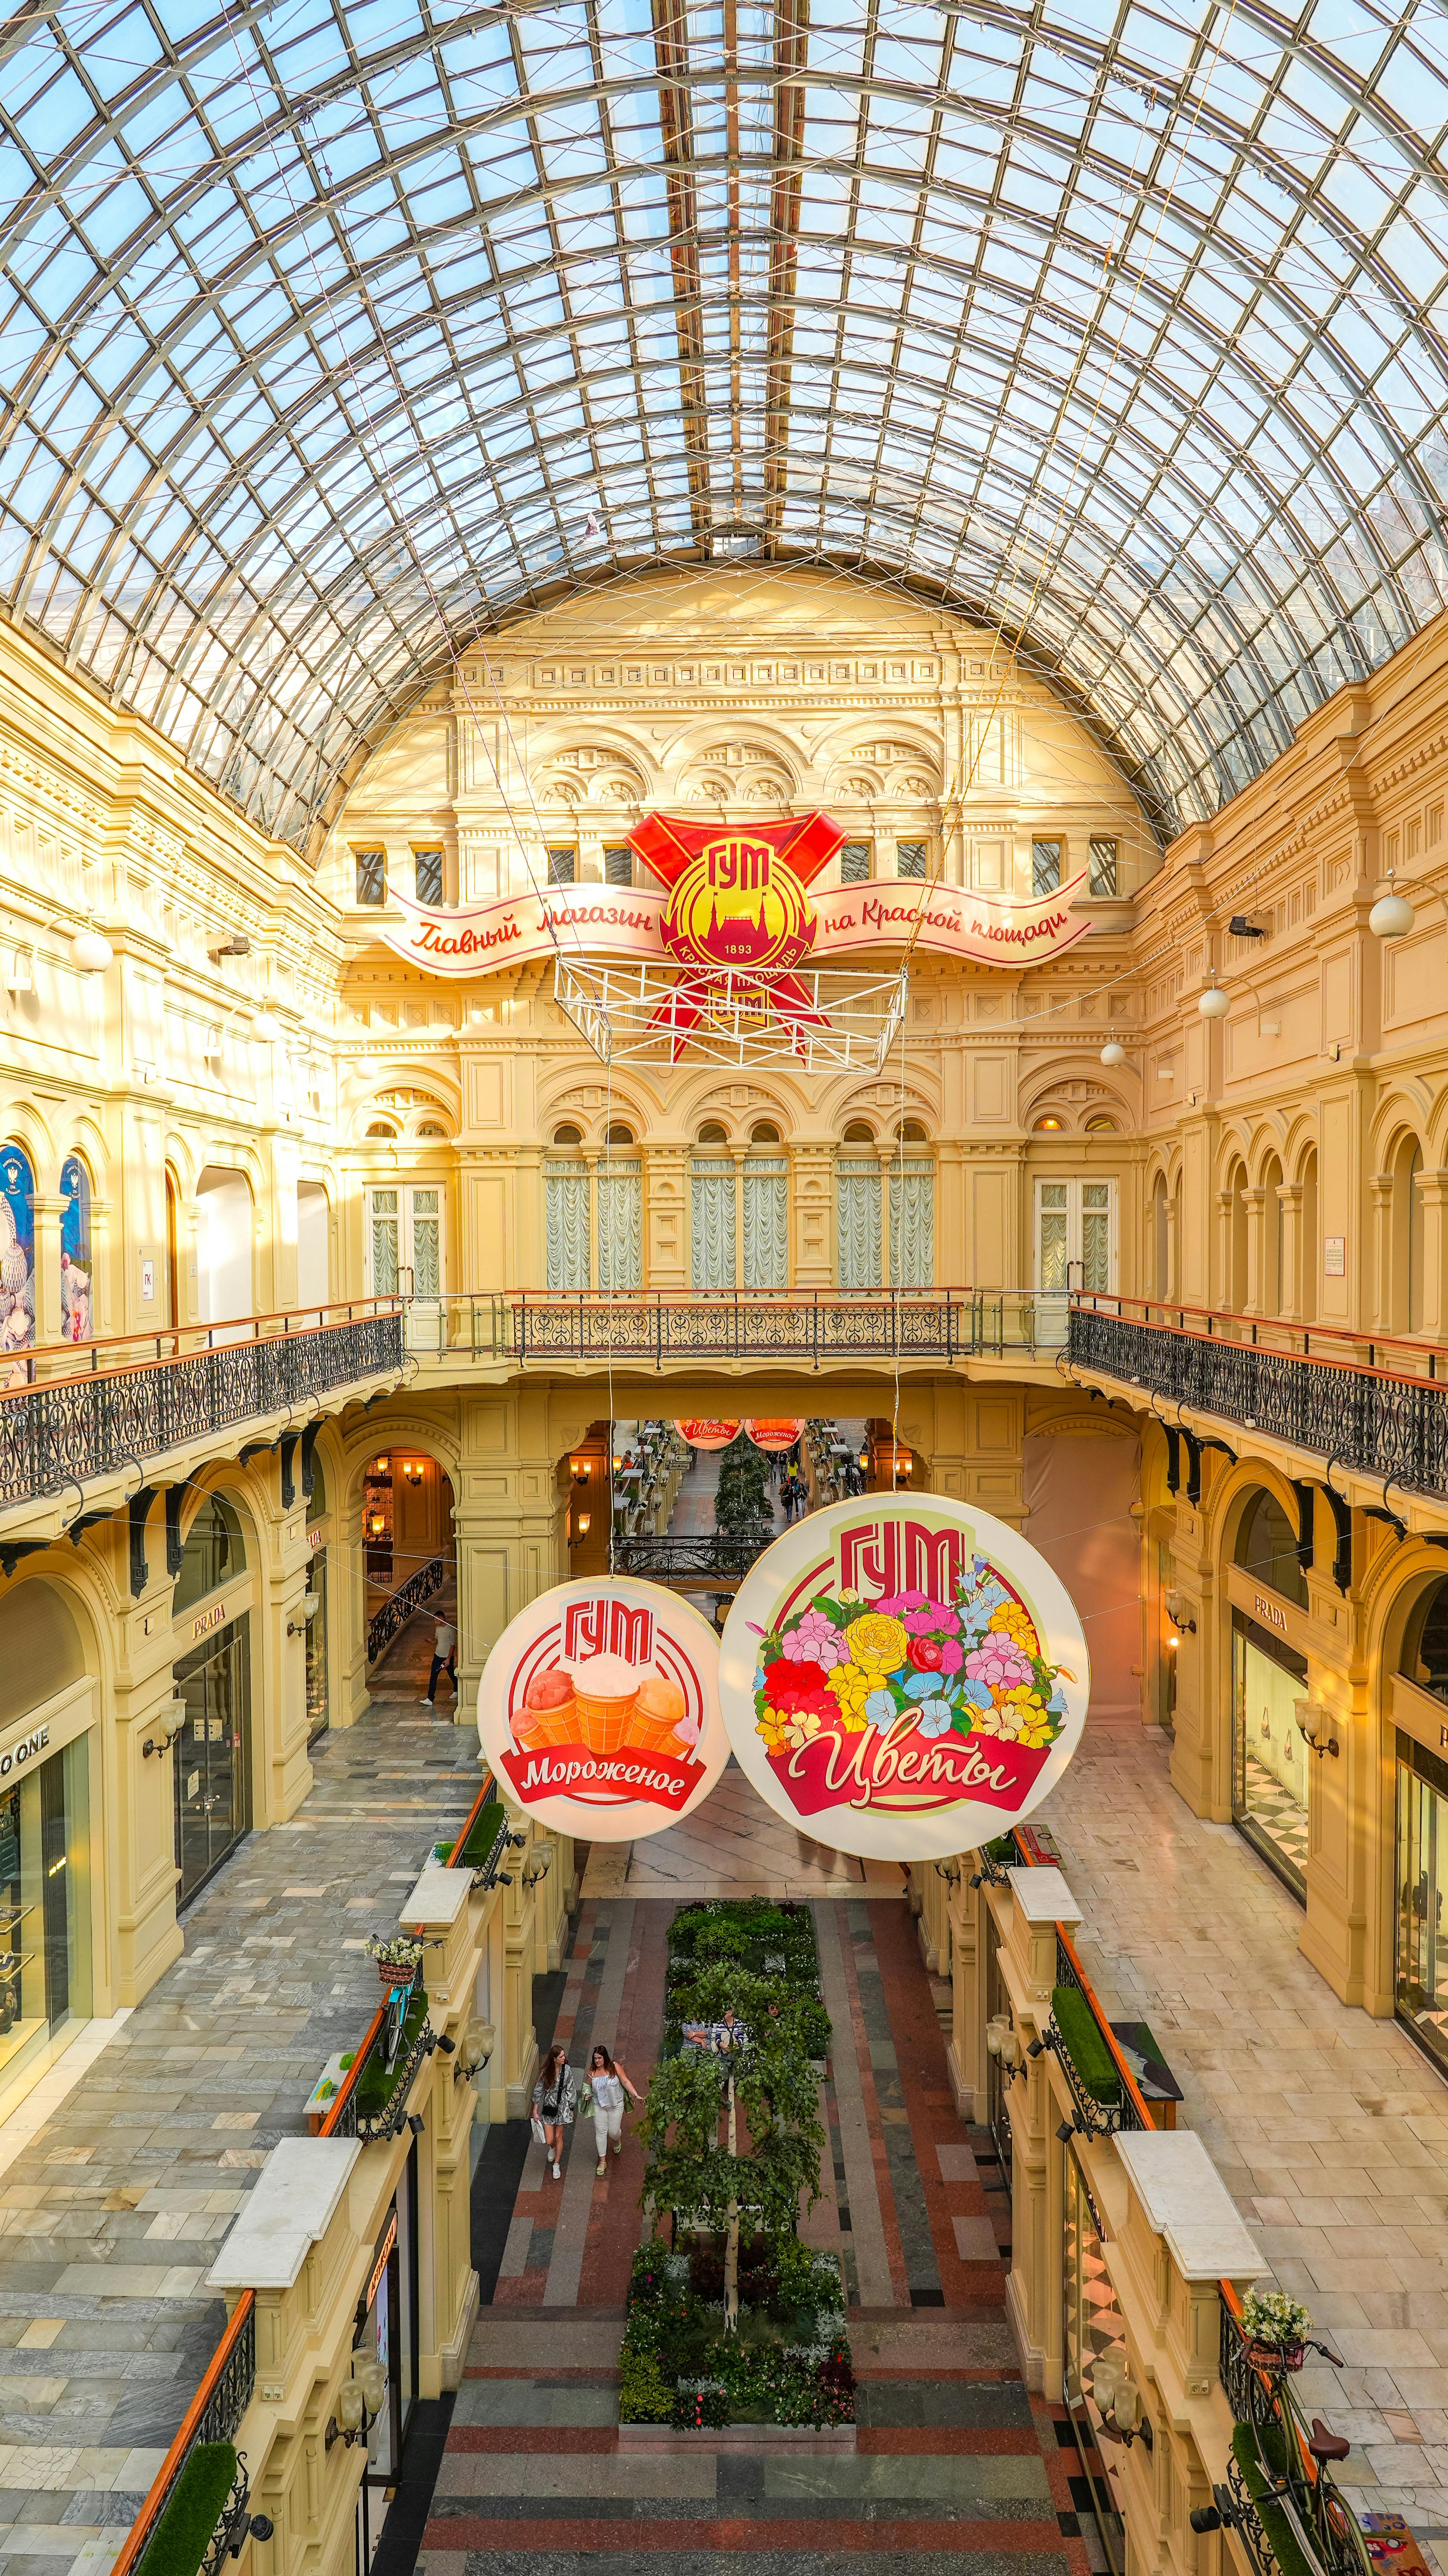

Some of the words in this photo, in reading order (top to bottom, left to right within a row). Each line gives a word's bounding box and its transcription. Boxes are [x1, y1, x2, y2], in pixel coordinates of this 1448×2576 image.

[708, 843, 769, 890] ГУМ
[410, 913, 522, 954] Главный
[536, 906, 654, 931] магазин
[825, 915, 856, 934] на
[862, 898, 961, 932] Красной
[970, 912, 1068, 946] площади
[724, 945, 752, 954] 1893
[715, 996, 763, 1017] GUM
[686, 1419, 732, 1438] Цветы
[755, 1431, 795, 1440] Мороженое
[840, 1520, 965, 1610] ГУМ
[192, 1603, 226, 1640] PRADA
[1255, 1594, 1288, 1632] PRADA
[564, 1600, 654, 1666] ГУМ
[13, 1724, 50, 1764] ONE
[788, 1706, 1021, 1809] Цветы
[520, 1756, 685, 1795] Мороженое
